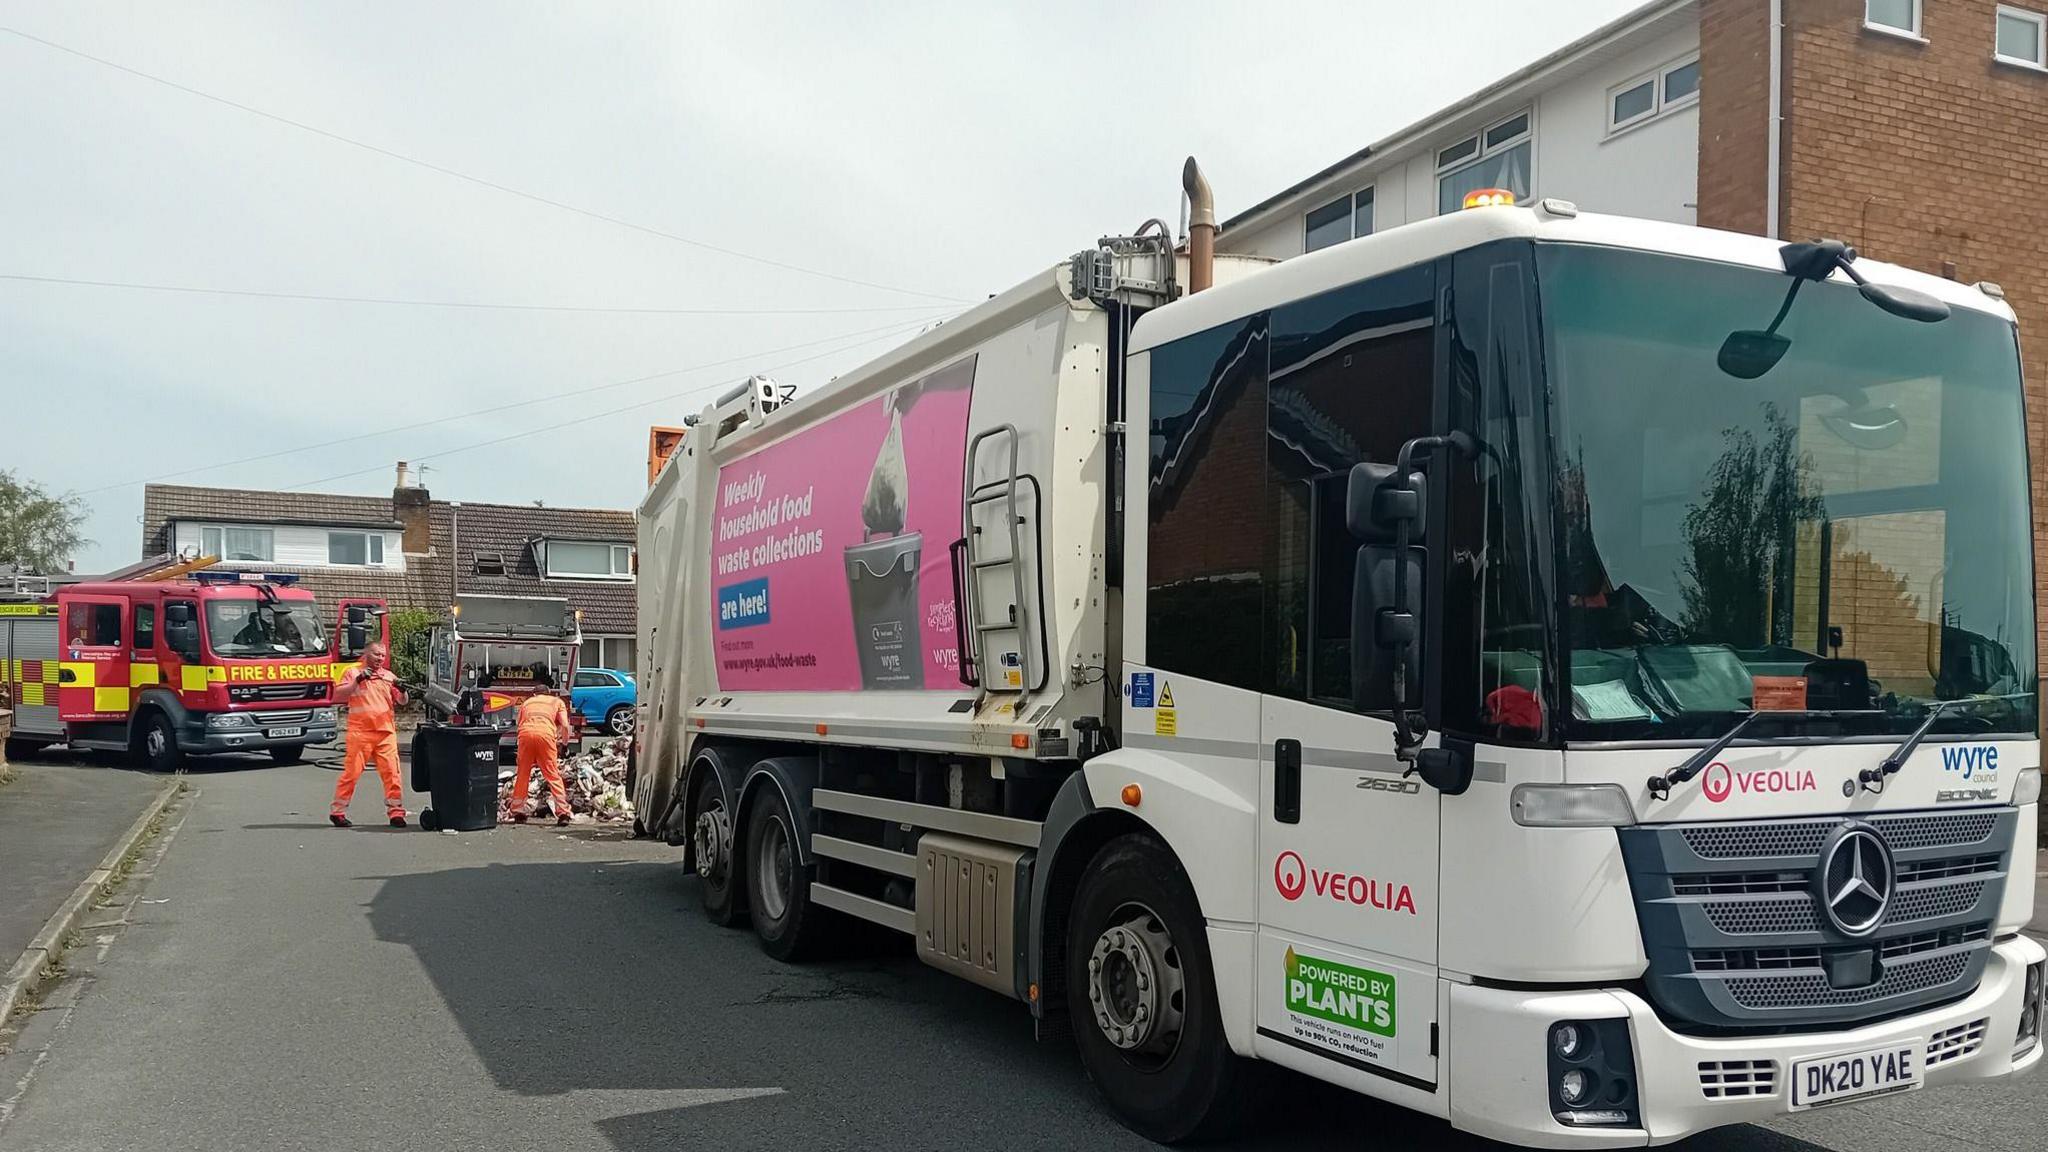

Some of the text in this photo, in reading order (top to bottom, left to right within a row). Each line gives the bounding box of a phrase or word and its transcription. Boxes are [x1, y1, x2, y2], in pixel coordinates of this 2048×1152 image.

[724, 471, 766, 508] Weekly
[720, 486, 813, 542] household food
[719, 526, 823, 575] waste collections
[721, 589, 767, 620] are here!
[231, 664, 328, 680] FIRE & RESCUE
[723, 653, 816, 672] www.wyre.gov.uk/food-waste
[881, 655, 900, 670] wyre
[933, 648, 959, 669] wyre
[475, 751, 494, 760] wyre
[1942, 746, 1998, 780] wyre
[1736, 770, 1816, 793] VEOLIA
[1973, 771, 1998, 783] council
[1311, 869, 1416, 915] VEOLIA
[1299, 963, 1390, 997] POWERED BY
[1291, 978, 1391, 1028] PLANTS
[1290, 1014, 1384, 1050] This vehicle runs on HVO fuel
[1294, 1026, 1303, 1036] Up
[1304, 1029, 1312, 1038] to
[1313, 1031, 1327, 1043] 90%
[1343, 1041, 1378, 1060] reduction
[1807, 1059, 1864, 1097] DK20
[1871, 1049, 1912, 1084] YAE
